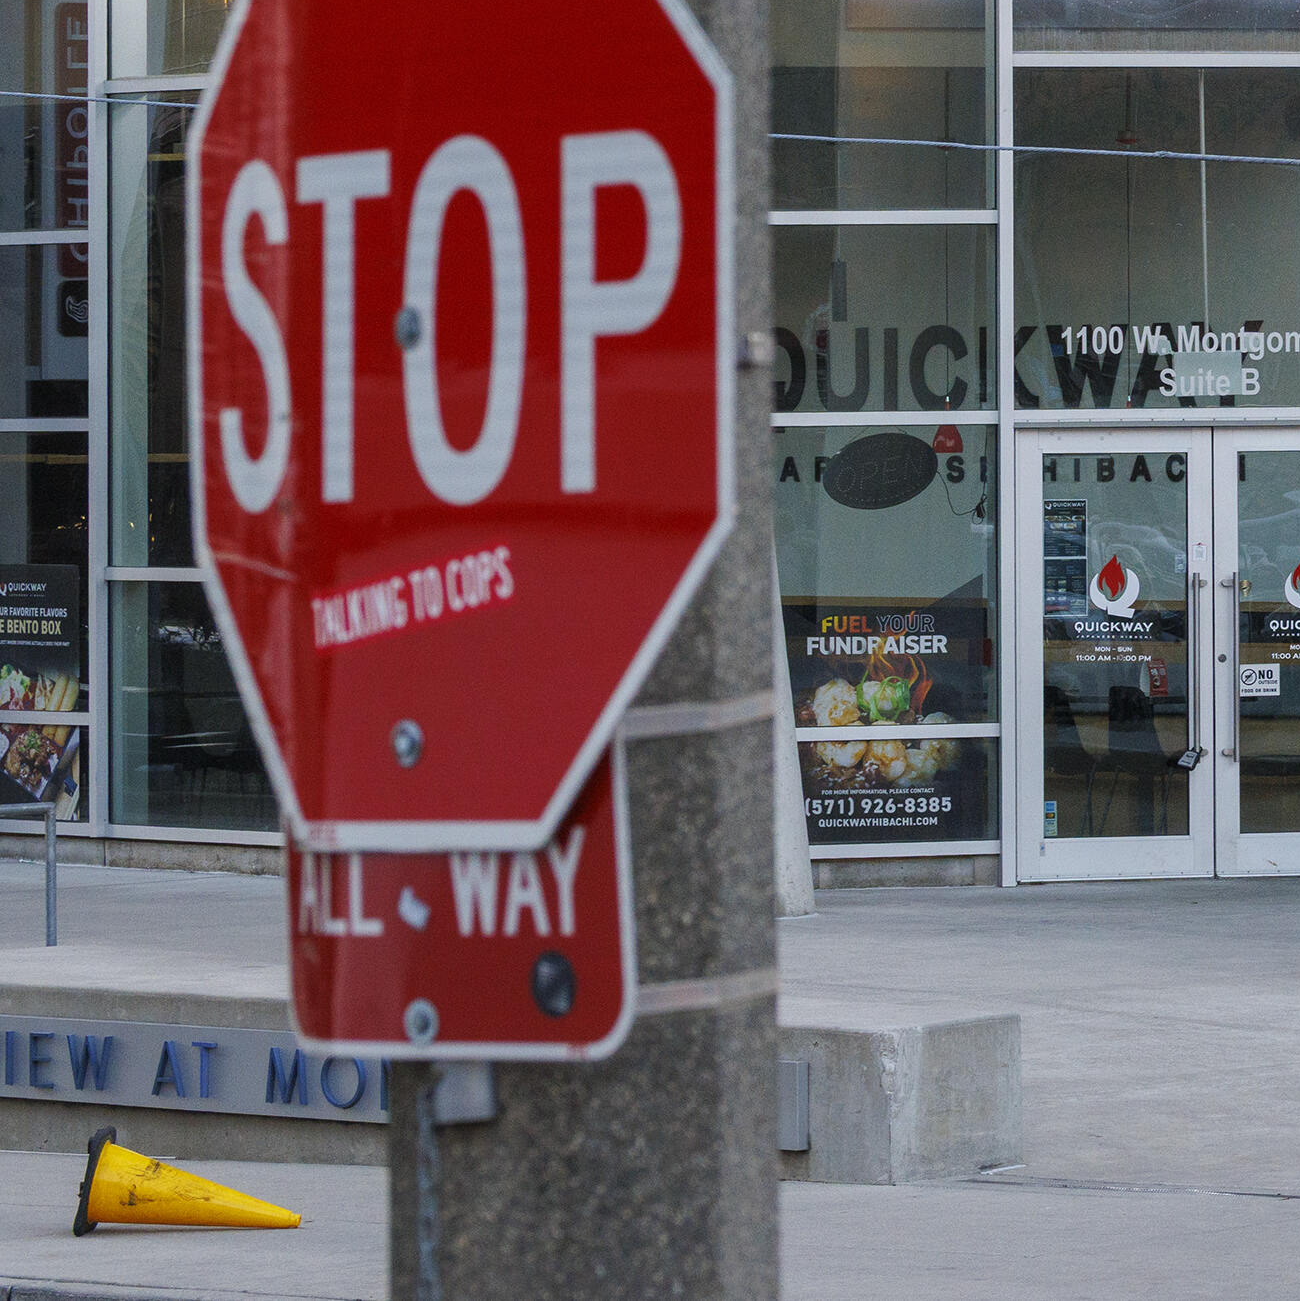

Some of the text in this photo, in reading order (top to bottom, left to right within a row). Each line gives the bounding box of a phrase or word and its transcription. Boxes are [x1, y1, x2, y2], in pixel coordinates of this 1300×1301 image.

[219, 128, 682, 513] STOP
[1061, 326, 1124, 354] 1100
[1159, 368, 1260, 396] Suite B
[8, 582, 47, 592] QUICKWAY
[311, 545, 514, 648] TALKING TO COPS
[9, 607, 39, 617] FAVORITE
[40, 607, 68, 617] FLAVORS
[7, 620, 39, 634] BENTO
[41, 620, 62, 635] BOX
[821, 614, 935, 633] FUEL YOUR
[1074, 621, 1153, 633] QUICKWAY
[807, 635, 948, 656] FUNDRAISER
[1258, 669, 1273, 679] NO
[805, 797, 952, 817] (571) 926-8385
[818, 816, 938, 828] QUICKWAYHIBACHI.COM
[299, 824, 586, 938] ALL WAY
[151, 1041, 218, 1098] AT
